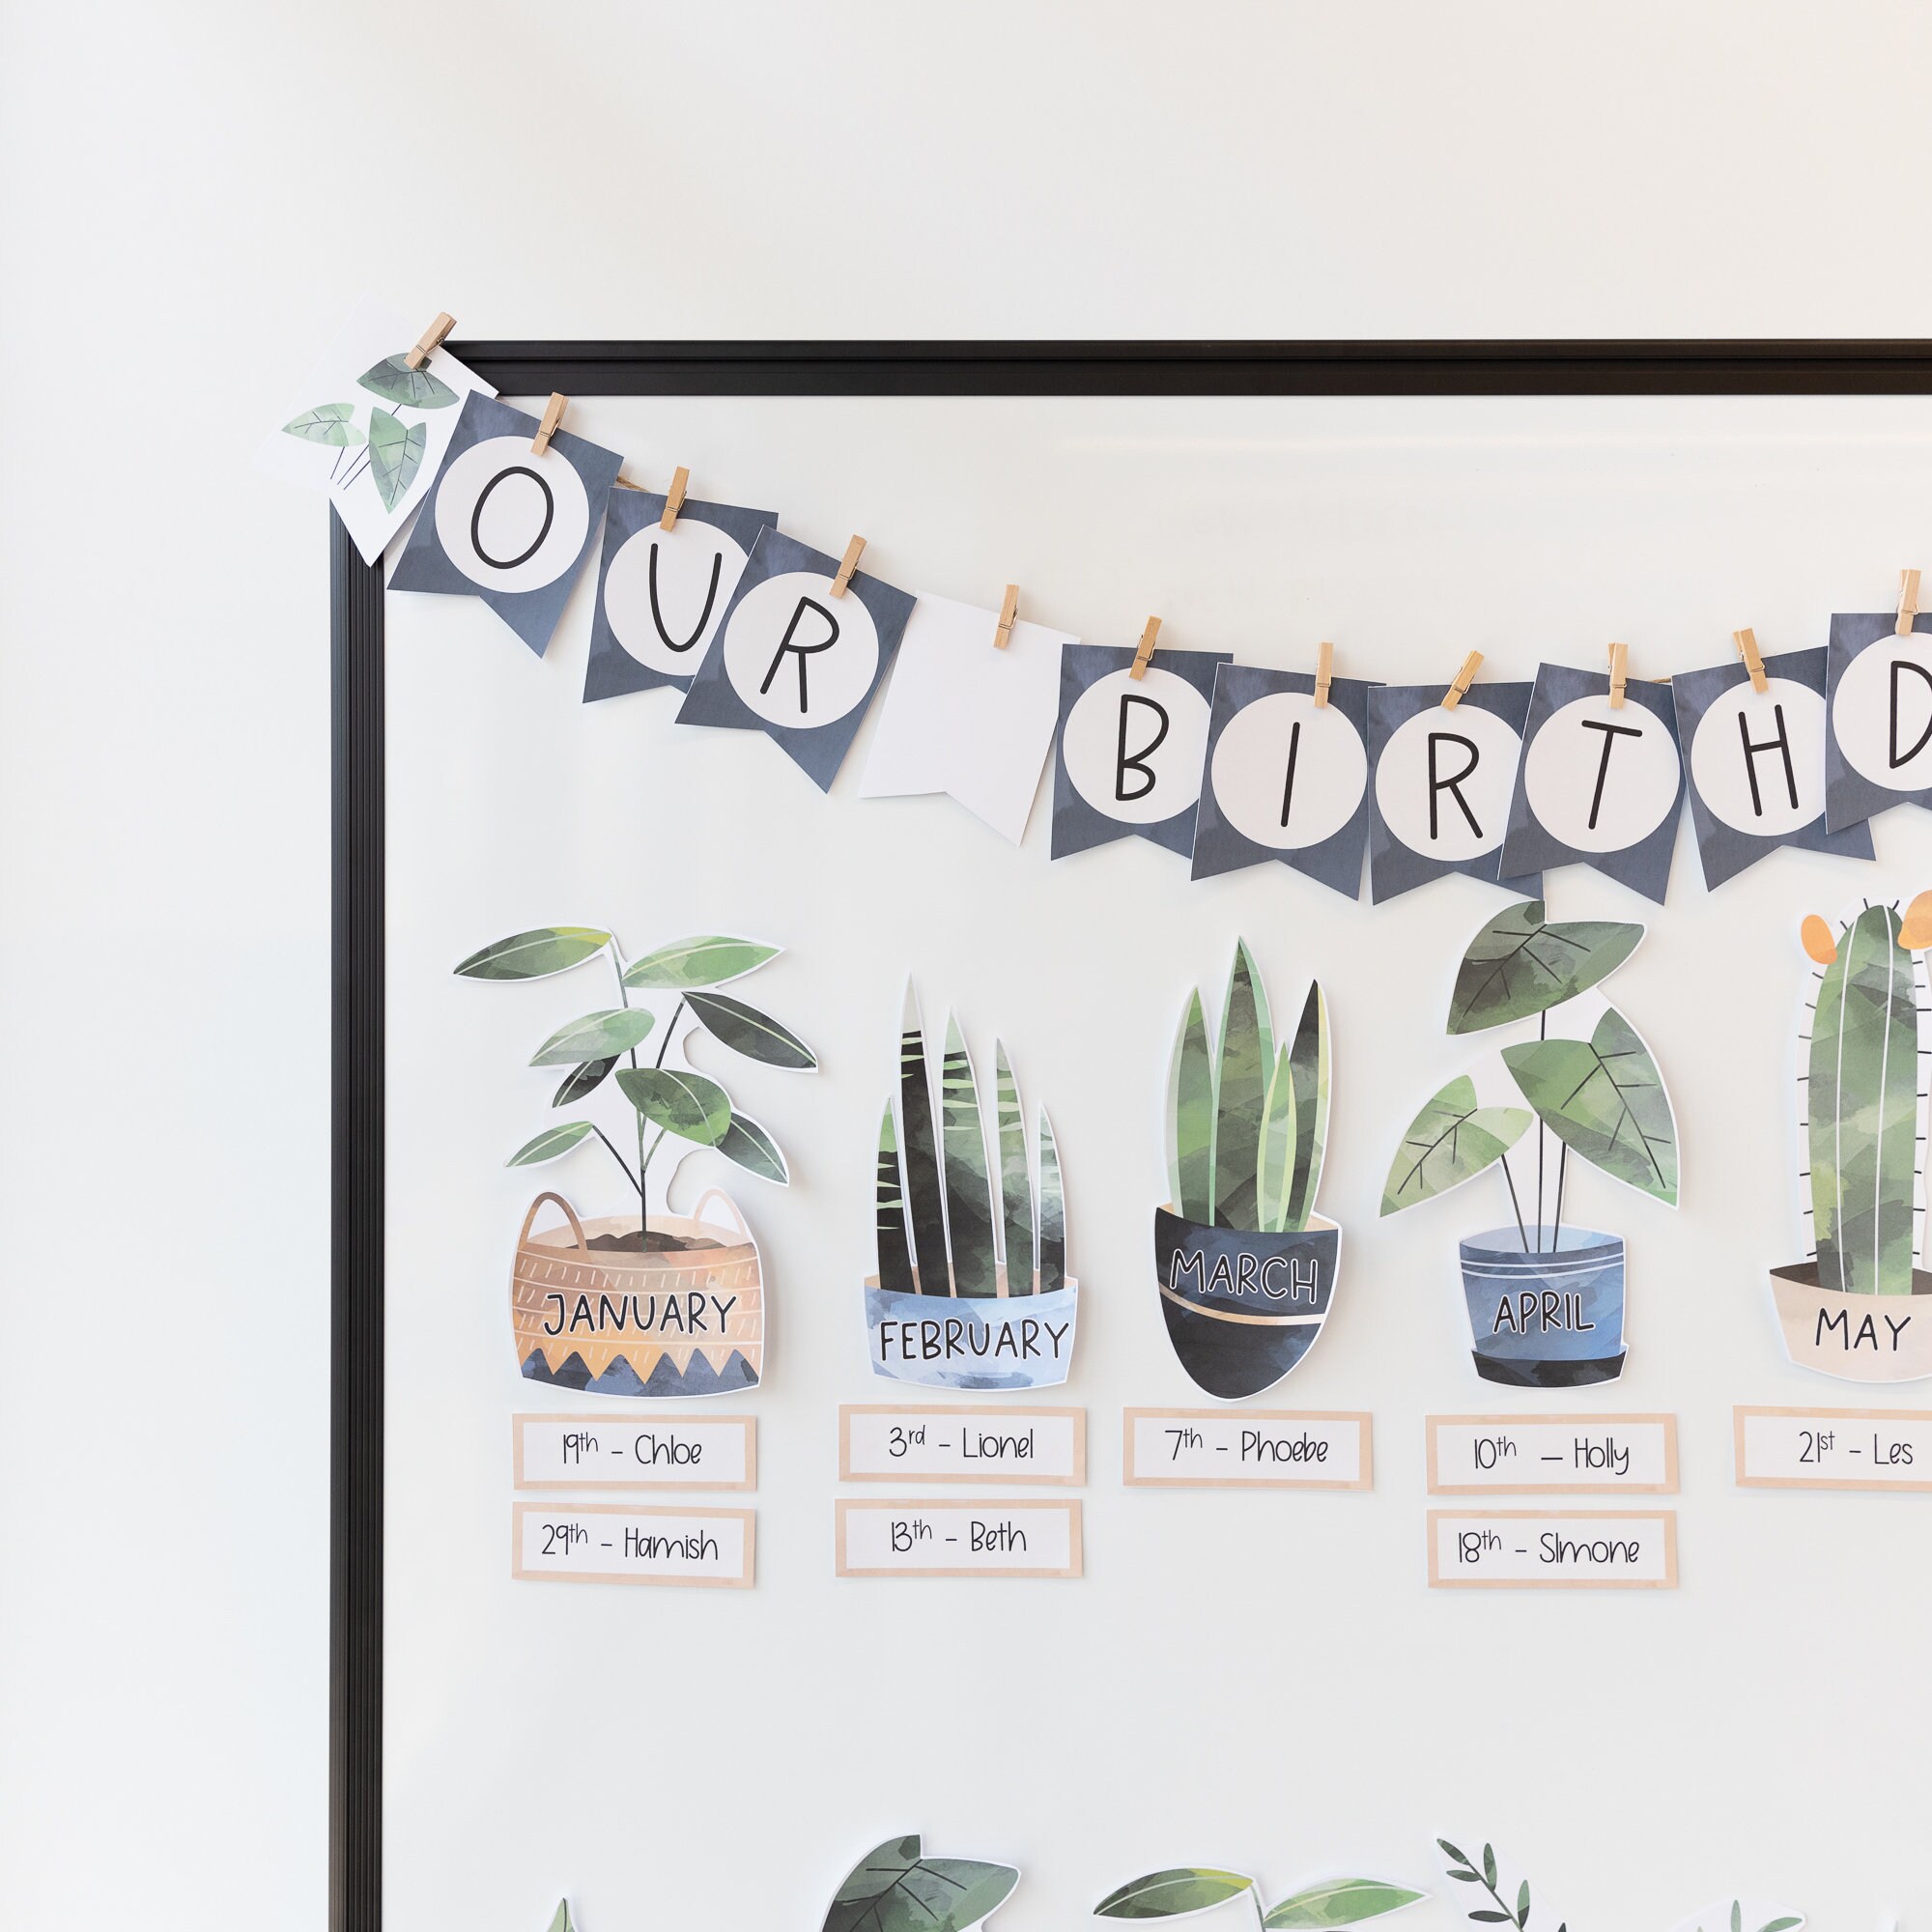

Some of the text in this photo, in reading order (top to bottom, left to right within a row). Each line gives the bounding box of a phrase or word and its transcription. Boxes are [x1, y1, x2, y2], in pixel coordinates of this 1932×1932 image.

[469, 465, 840, 715] OUR
[1115, 660, 1932, 840] BIRTHD
[1170, 1249, 1320, 1304] MARCH
[543, 1292, 738, 1336] JANUARY
[1492, 1291, 1595, 1334] APRIL
[1814, 1306, 1913, 1352] MAY
[879, 1319, 1070, 1361] FEBRUARY
[562, 1430, 600, 1465] 19th
[634, 1433, 703, 1466] Chloe
[888, 1423, 926, 1459] 3rd
[962, 1426, 1035, 1460] Lionel
[1163, 1426, 1204, 1462] 7th
[1240, 1429, 1330, 1463] Phoebe
[1473, 1435, 1518, 1470] 10th
[1574, 1435, 1631, 1477] Holly
[1798, 1429, 1836, 1464] 21st
[1873, 1432, 1915, 1466] Les
[540, 1521, 589, 1557] 29th
[623, 1525, 720, 1562] Hamish
[890, 1518, 933, 1553] 13th
[970, 1520, 1028, 1553] Beth
[1457, 1528, 1503, 1564] 18th
